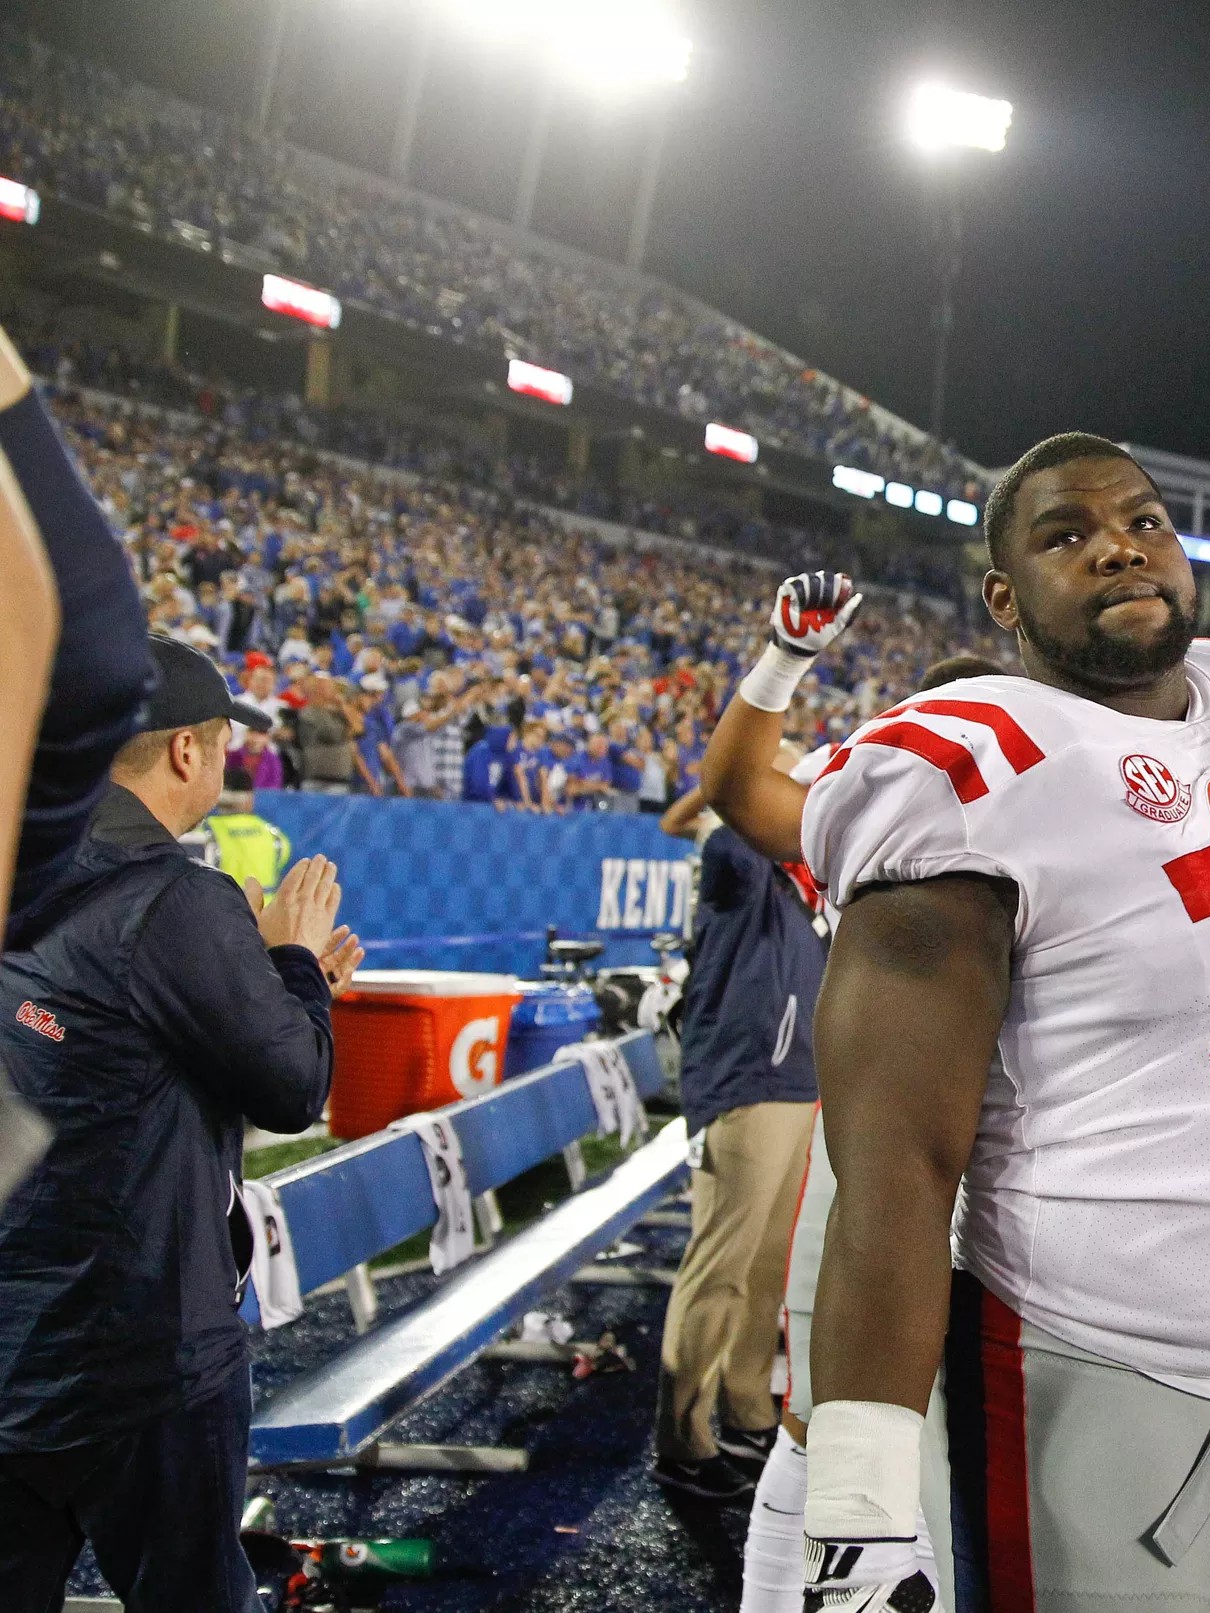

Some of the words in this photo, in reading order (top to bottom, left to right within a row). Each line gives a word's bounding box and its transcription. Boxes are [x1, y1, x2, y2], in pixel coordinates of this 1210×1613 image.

[1124, 756, 1174, 804] SEC
[1139, 795, 1189, 820] GRADUATE
[16, 1001, 37, 1027] Ole
[32, 1009, 66, 1041] Miss
[450, 1016, 499, 1100] G
